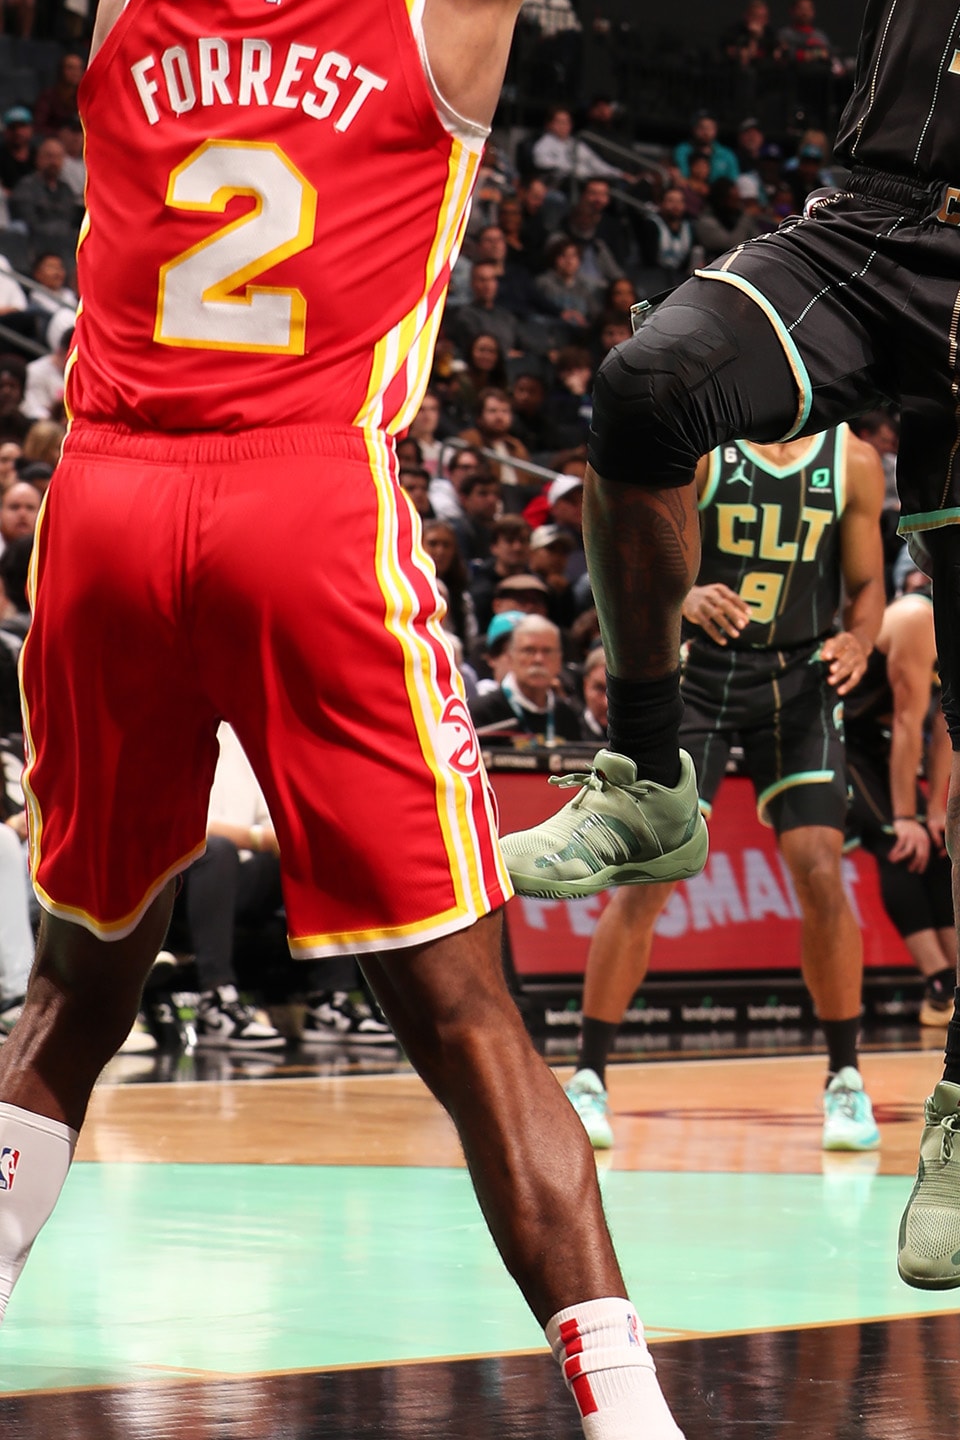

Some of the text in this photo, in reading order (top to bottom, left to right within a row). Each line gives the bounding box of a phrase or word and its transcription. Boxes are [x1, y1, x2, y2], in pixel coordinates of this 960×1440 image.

[131, 37, 389, 133] FORREST
[153, 138, 318, 355] 2
[724, 446, 739, 464] 6
[716, 503, 834, 562] CLT
[738, 571, 785, 625] 9
